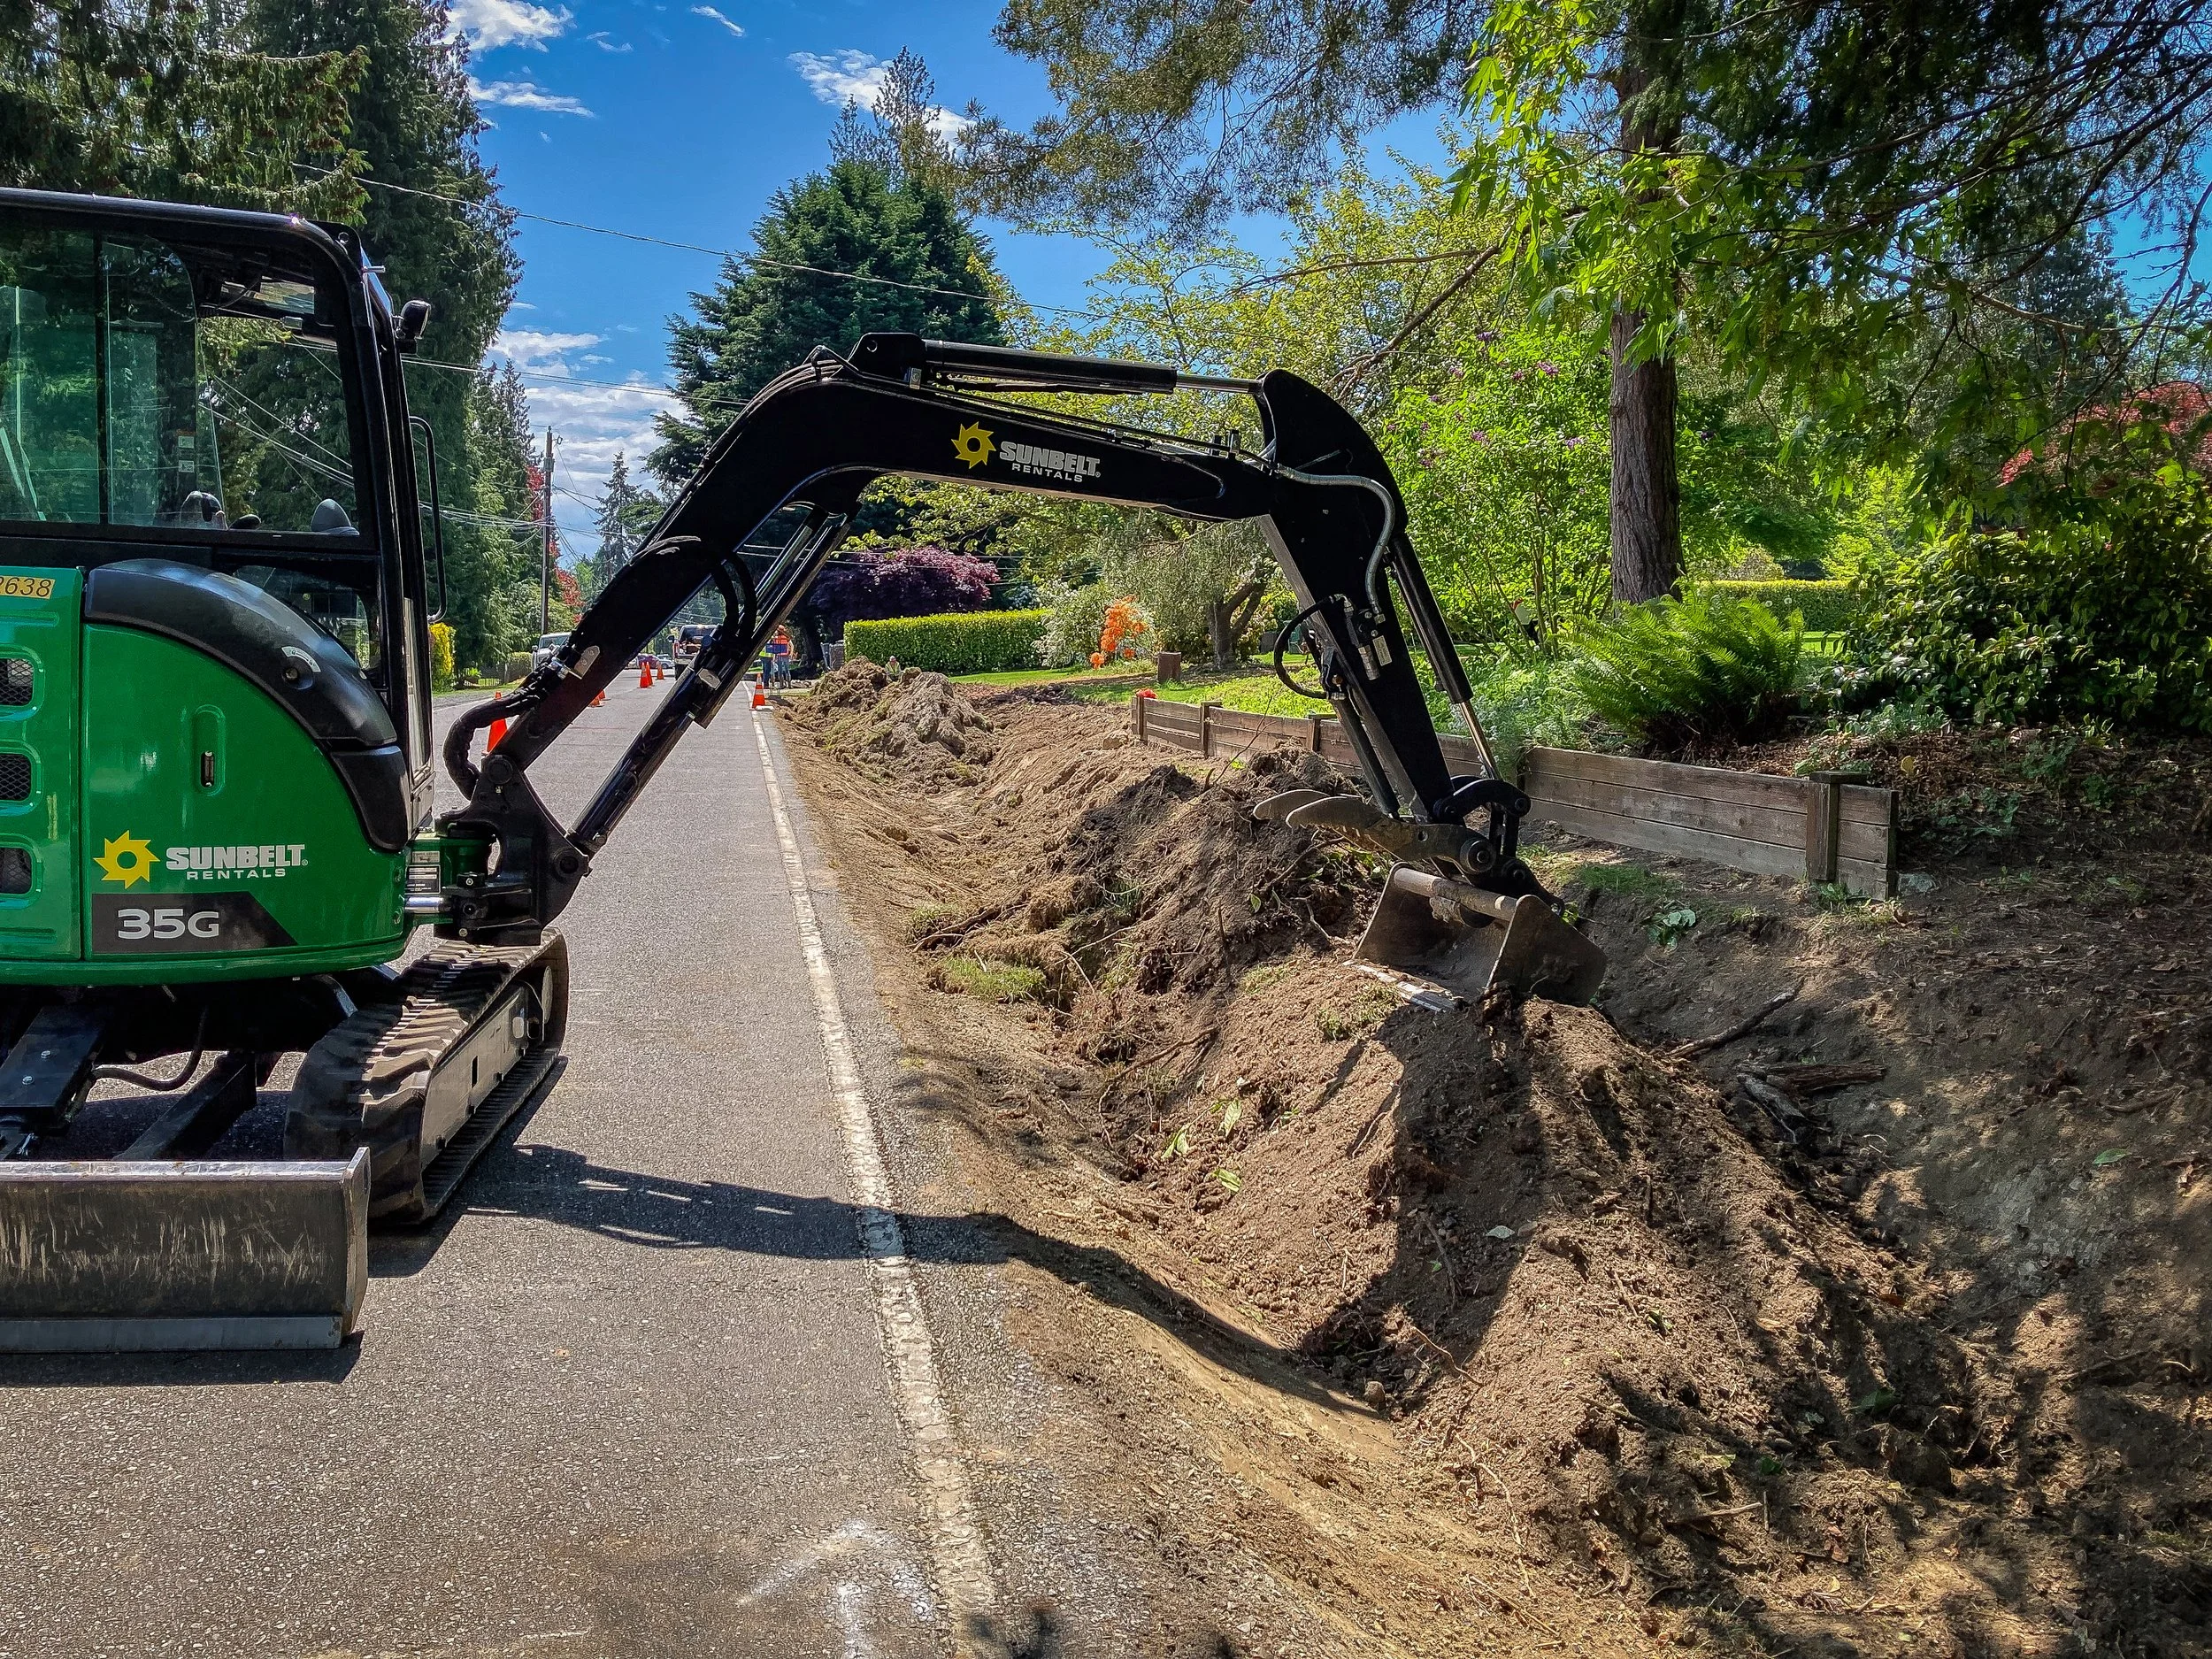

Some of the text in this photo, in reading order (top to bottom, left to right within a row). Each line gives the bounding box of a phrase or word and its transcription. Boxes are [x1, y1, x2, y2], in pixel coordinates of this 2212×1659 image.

[999, 441, 1101, 477] SUNBELT
[1011, 462, 1083, 482] RENTALS
[165, 843, 305, 871] SUNBELT
[186, 868, 286, 880] RENTALS
[117, 908, 219, 940] 35G
